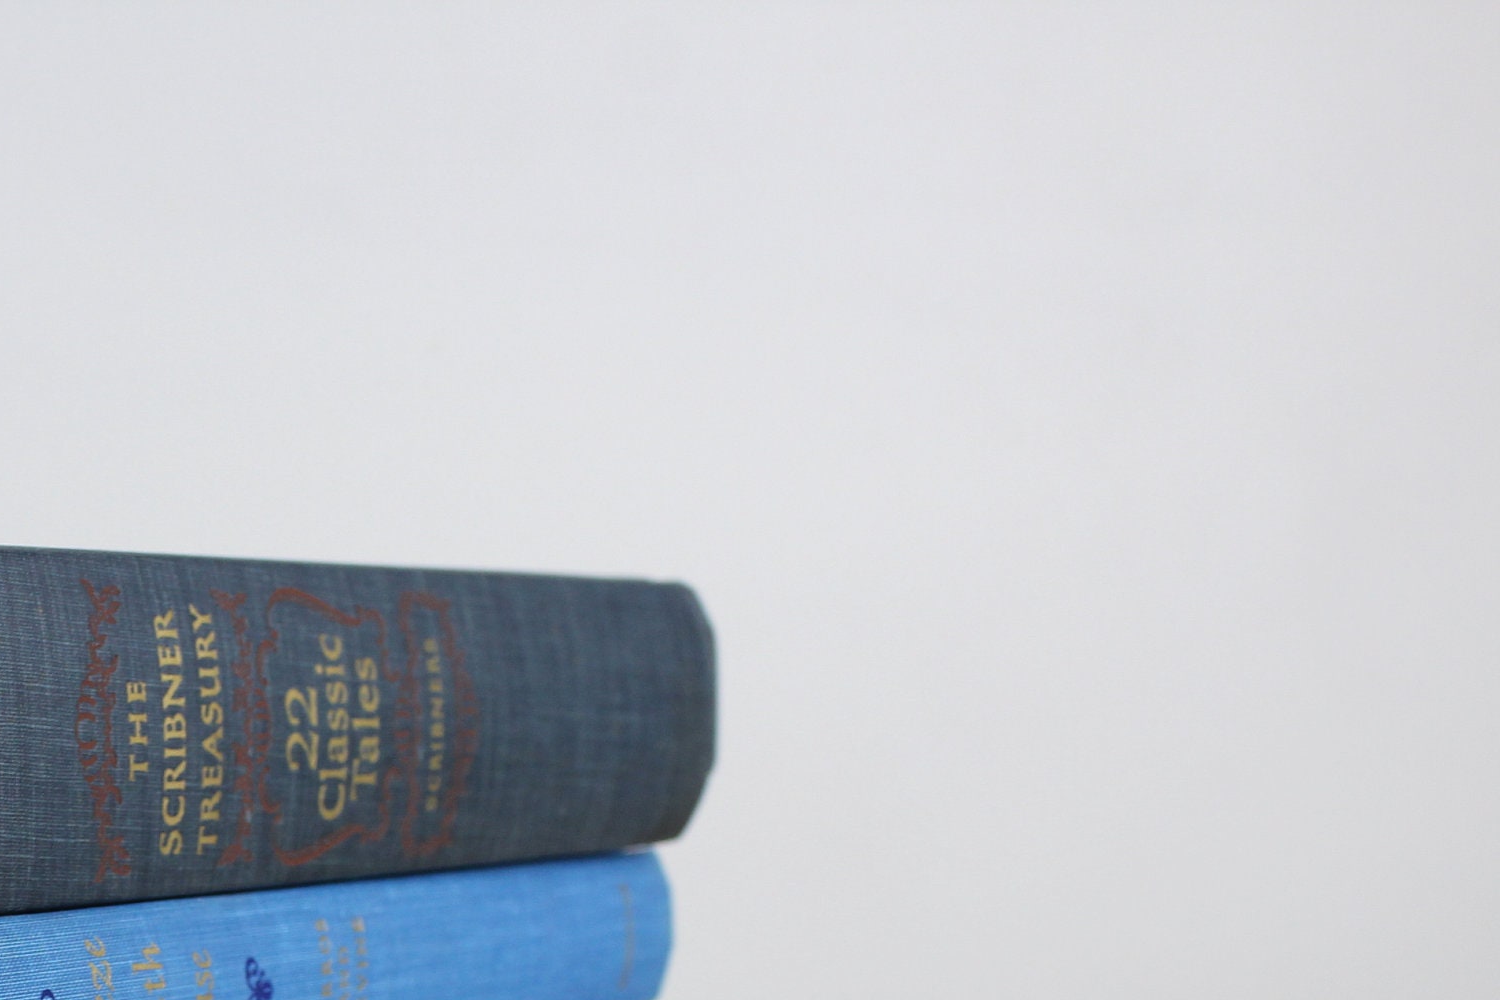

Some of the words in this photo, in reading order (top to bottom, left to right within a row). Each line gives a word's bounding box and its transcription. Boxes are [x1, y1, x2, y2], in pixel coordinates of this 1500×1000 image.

[126, 681, 148, 781] THE
[153, 608, 187, 855] SCRIBNER
[189, 603, 223, 855] TREASURY
[285, 686, 319, 772] 22
[314, 634, 349, 821] Classic
[350, 657, 381, 800] Tales
